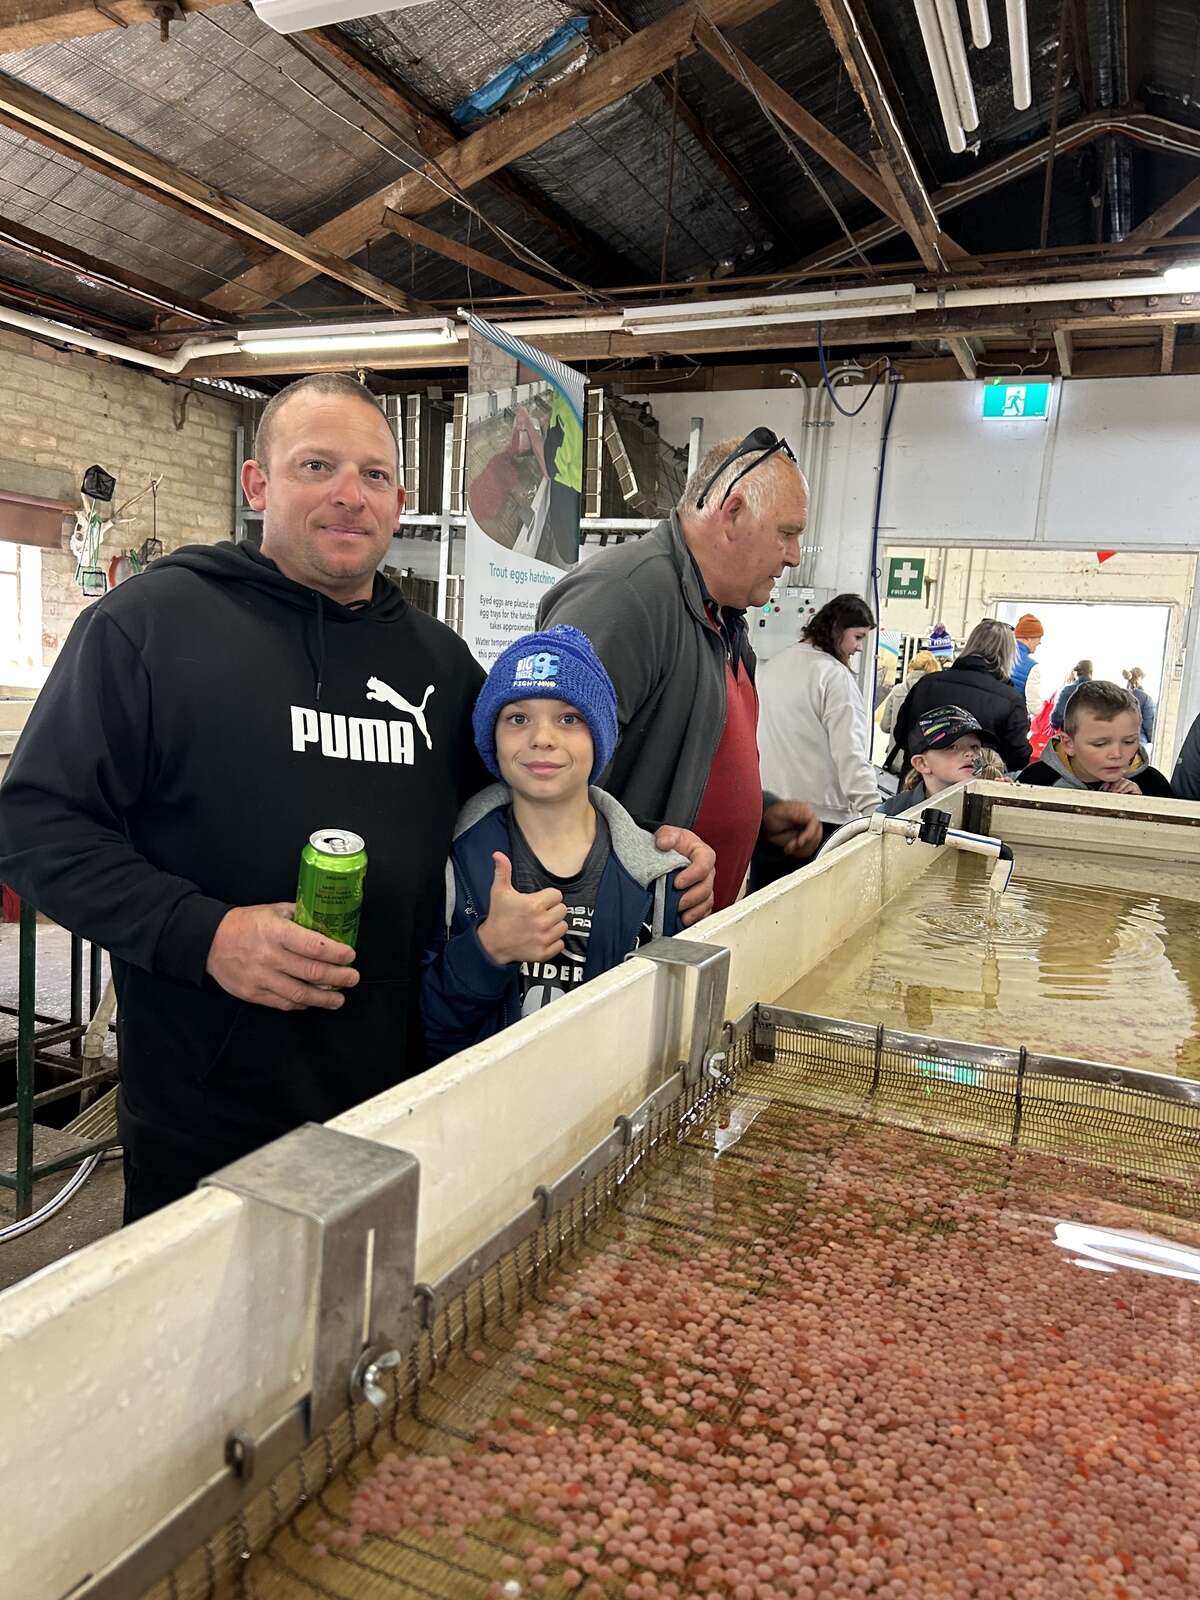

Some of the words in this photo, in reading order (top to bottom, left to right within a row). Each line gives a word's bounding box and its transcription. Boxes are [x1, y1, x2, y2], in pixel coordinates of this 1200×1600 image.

[489, 562, 508, 579] Trout
[510, 569, 528, 584] eggs
[479, 594, 492, 606] Eyed
[493, 598, 504, 608] eggs
[513, 598, 529, 609] placed
[479, 608, 489, 619] egg
[490, 609, 501, 619] trays
[502, 608, 510, 618] for
[510, 609, 519, 619] the
[489, 621, 502, 630] takes
[475, 636, 490, 646] Water
[478, 650, 487, 658] this
[516, 653, 534, 672] BIG
[290, 705, 415, 766] PUMA
[566, 906, 586, 915] AS
[572, 917, 592, 929] RA
[520, 961, 584, 982] AIDER
